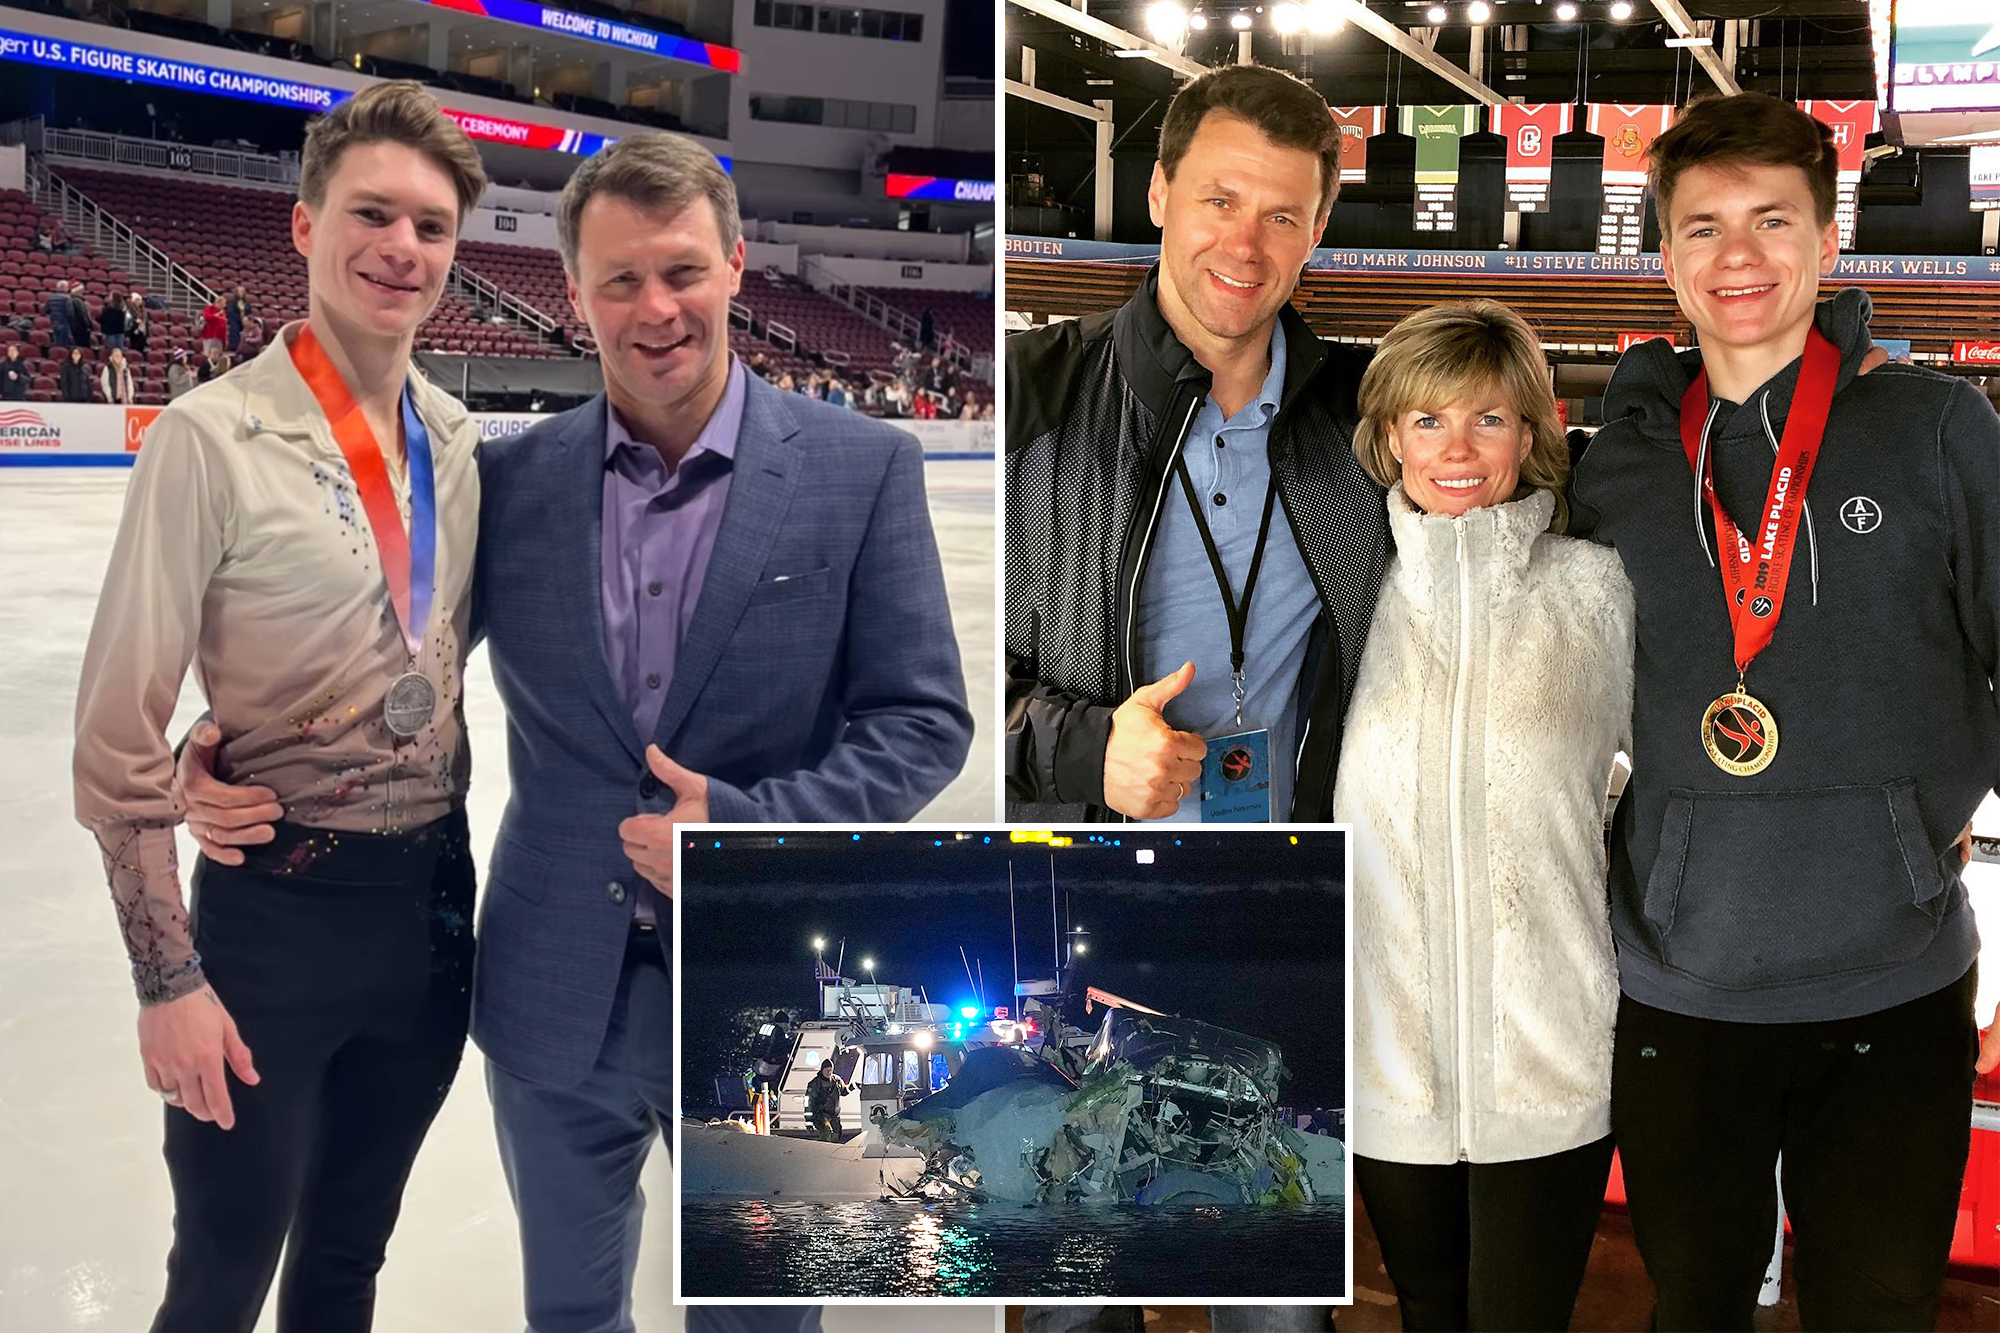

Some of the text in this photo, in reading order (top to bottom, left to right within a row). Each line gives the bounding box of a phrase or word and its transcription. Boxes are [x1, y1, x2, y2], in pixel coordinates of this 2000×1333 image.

[541, 8, 659, 49] WELCOME TO WICHITA!
[33, 40, 66, 62] U.S.
[70, 46, 134, 73] FIGURE
[137, 59, 206, 86] SKATING
[209, 72, 332, 106] CHAMPIONSHIPS
[462, 117, 529, 141] CEREMONY
[1833, 125, 1848, 144] H
[169, 150, 191, 168] 103
[498, 217, 515, 231] 104
[1005, 238, 1063, 255] BROTEN
[1332, 252, 1486, 269] #10 MARK JOHNSON
[1504, 255, 1662, 271] #11 STEVE CHRISTO
[1839, 260, 1967, 275] MARK WELLS
[1979, 376, 1987, 386] 7
[0, 427, 61, 438] ERICAN
[24, 438, 61, 447] LINES
[1855, 499, 1867, 513] A
[1754, 467, 1792, 590] 2019 LAKE PLACID
[1768, 450, 1811, 594] FIGURE SKATING CHAMPIONSHIPS
[1857, 517, 1866, 530] F
[1722, 510, 1741, 585] CHAMPIONSHIPS
[1737, 697, 1768, 719] PLACID
[1738, 729, 1775, 773] CHAMPIONSHIPS
